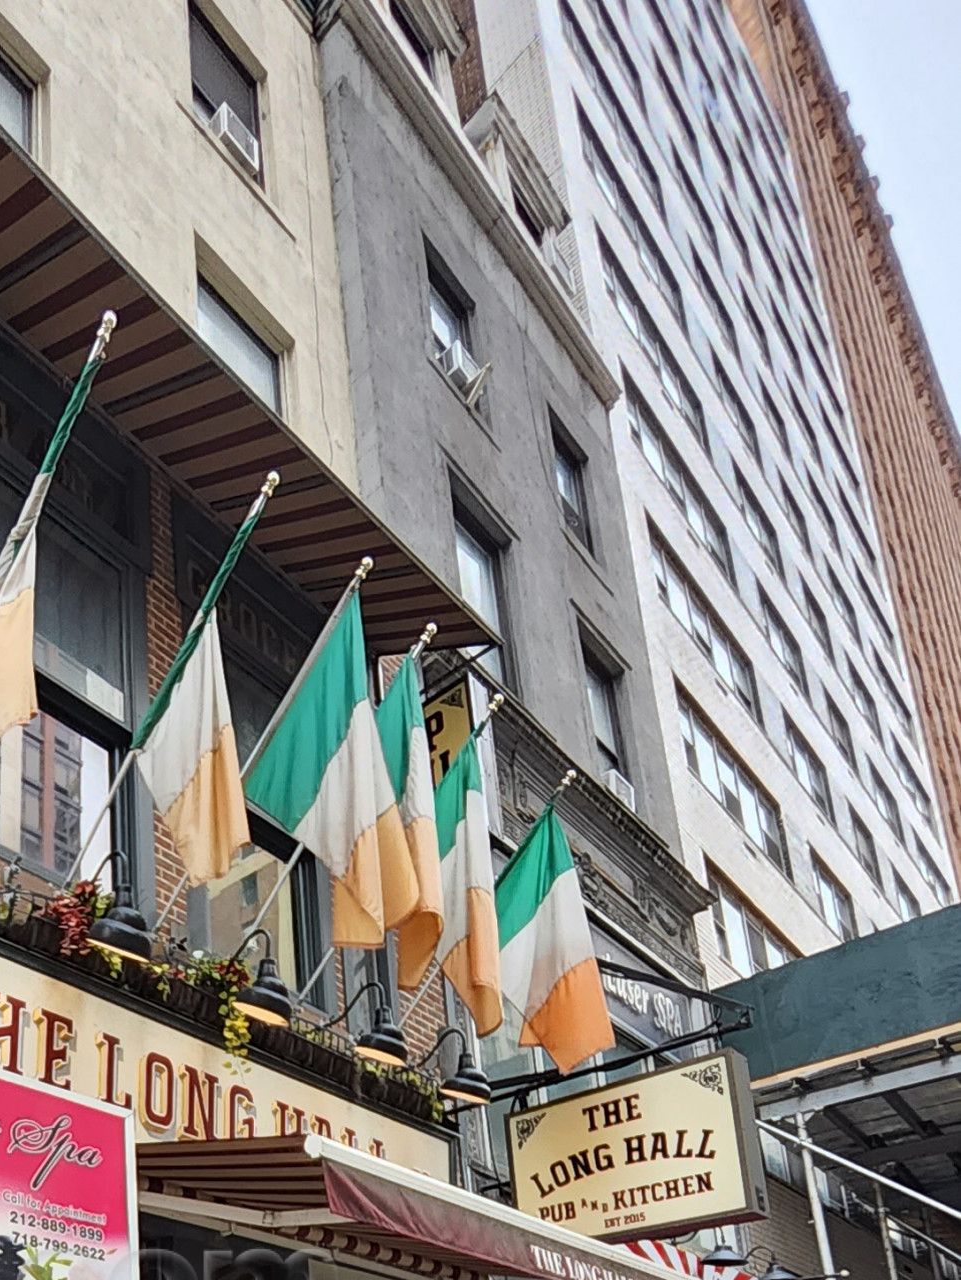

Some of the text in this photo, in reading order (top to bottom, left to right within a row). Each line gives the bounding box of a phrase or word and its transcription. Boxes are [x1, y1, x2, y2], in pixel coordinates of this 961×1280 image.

[94, 1030, 258, 1142] LONG
[582, 1094, 643, 1132] THE
[7, 1115, 104, 1189] Spa
[530, 1129, 717, 1199] LONG HALL
[2, 1190, 107, 1225] Call for Appointment
[539, 1172, 715, 1223] PUB AND KITCHEN
[10, 1211, 103, 1242] 212-889-1899
[624, 1212, 647, 1226] 2015
[12, 1231, 106, 1260] 718-799-2622
[530, 1244, 563, 1278] THE
